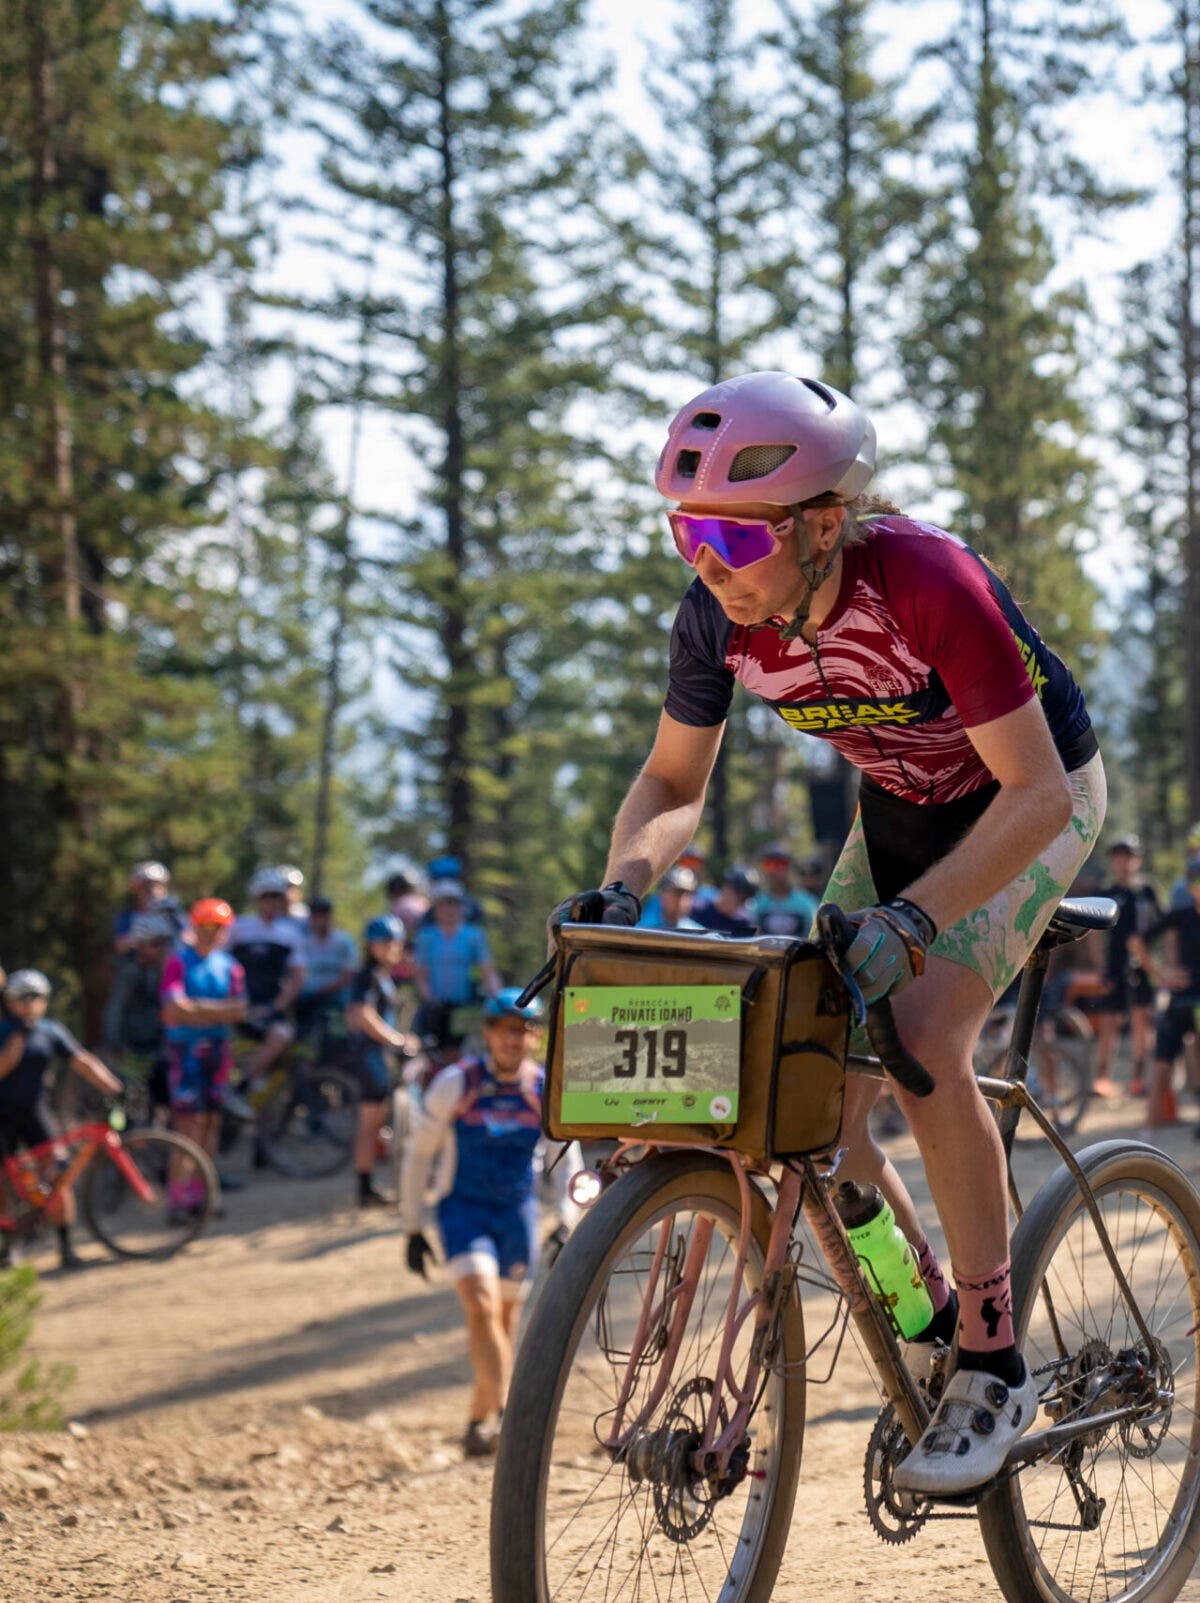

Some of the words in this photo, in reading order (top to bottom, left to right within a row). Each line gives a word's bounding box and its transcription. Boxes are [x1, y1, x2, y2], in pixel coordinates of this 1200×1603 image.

[779, 703, 914, 720] BREAK
[611, 1006, 656, 1022] PRIVATE
[659, 1006, 692, 1022] IDAHO
[614, 1030, 687, 1078] 319
